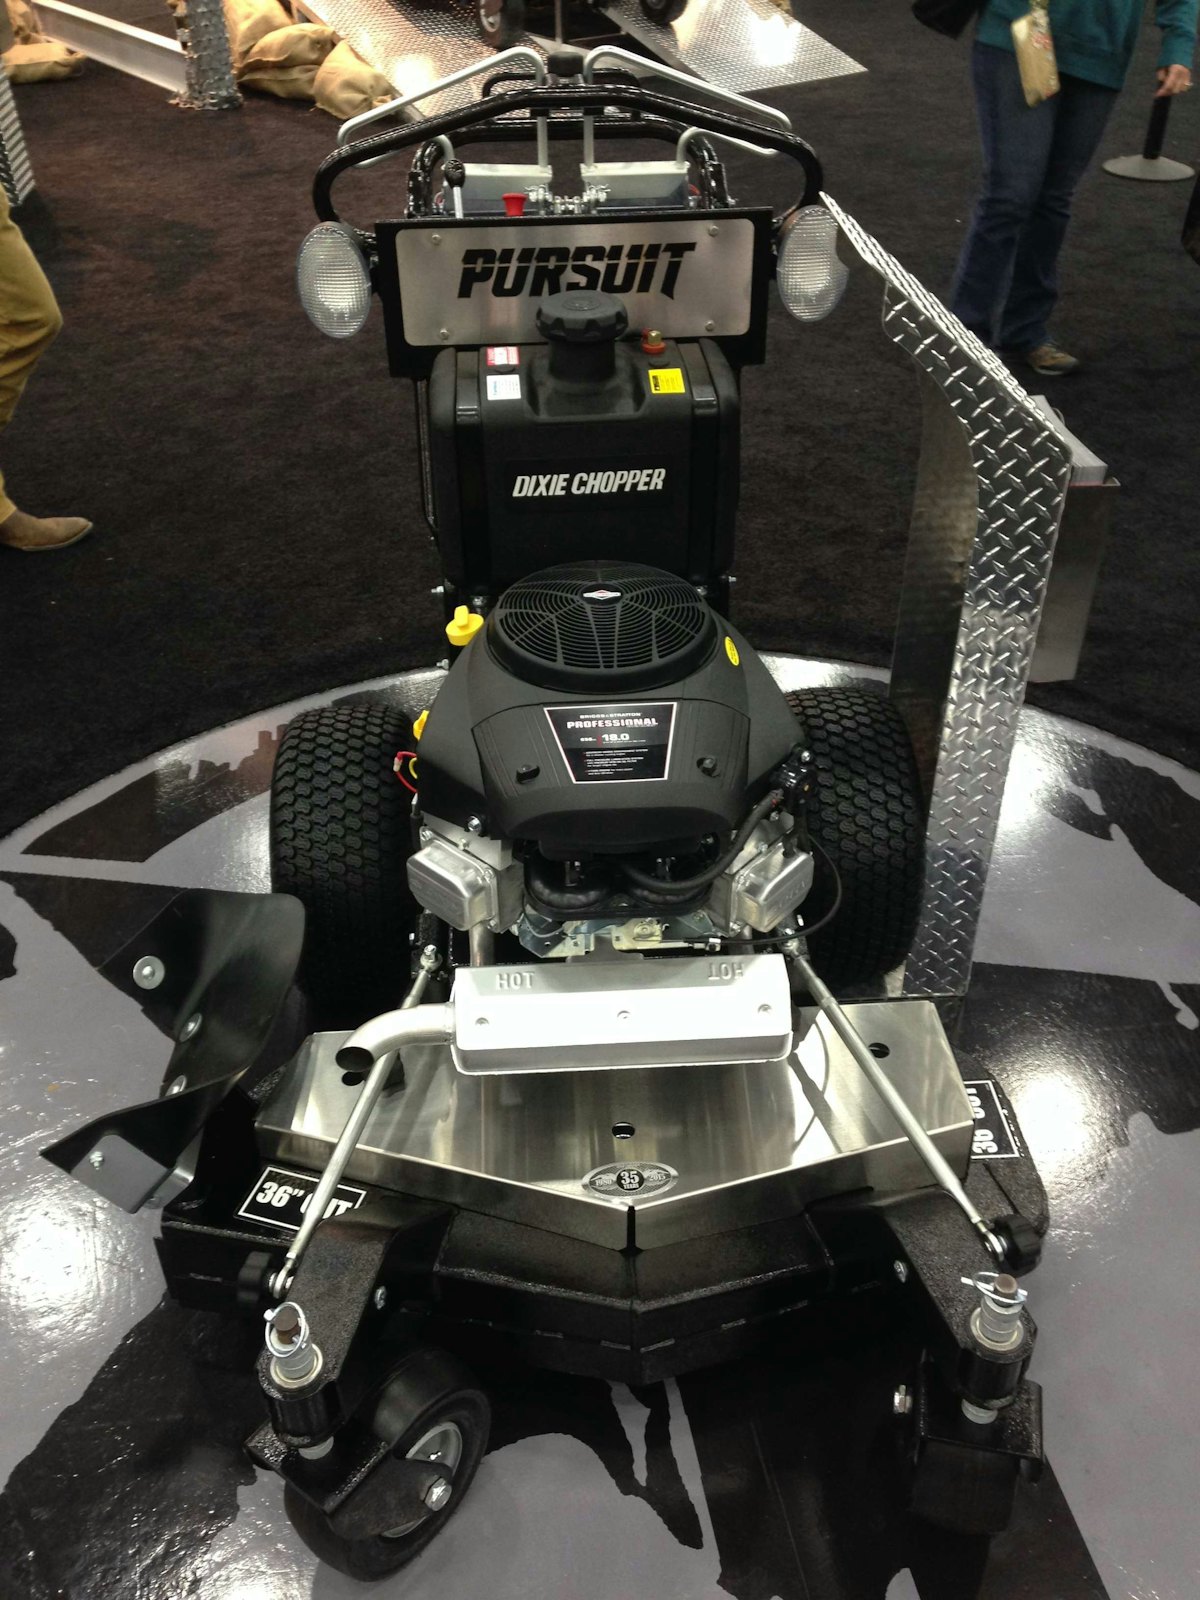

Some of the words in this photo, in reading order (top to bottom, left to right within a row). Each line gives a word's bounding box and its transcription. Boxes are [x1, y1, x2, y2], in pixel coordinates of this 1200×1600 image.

[457, 242, 697, 299] PURSUIT
[512, 474, 570, 497] DIXIE
[571, 468, 666, 494] CHOPPER
[566, 718, 659, 728] PROFESSIONAL
[496, 972, 534, 990] HOT
[708, 963, 744, 981] HOT
[620, 1171, 640, 1184] 35
